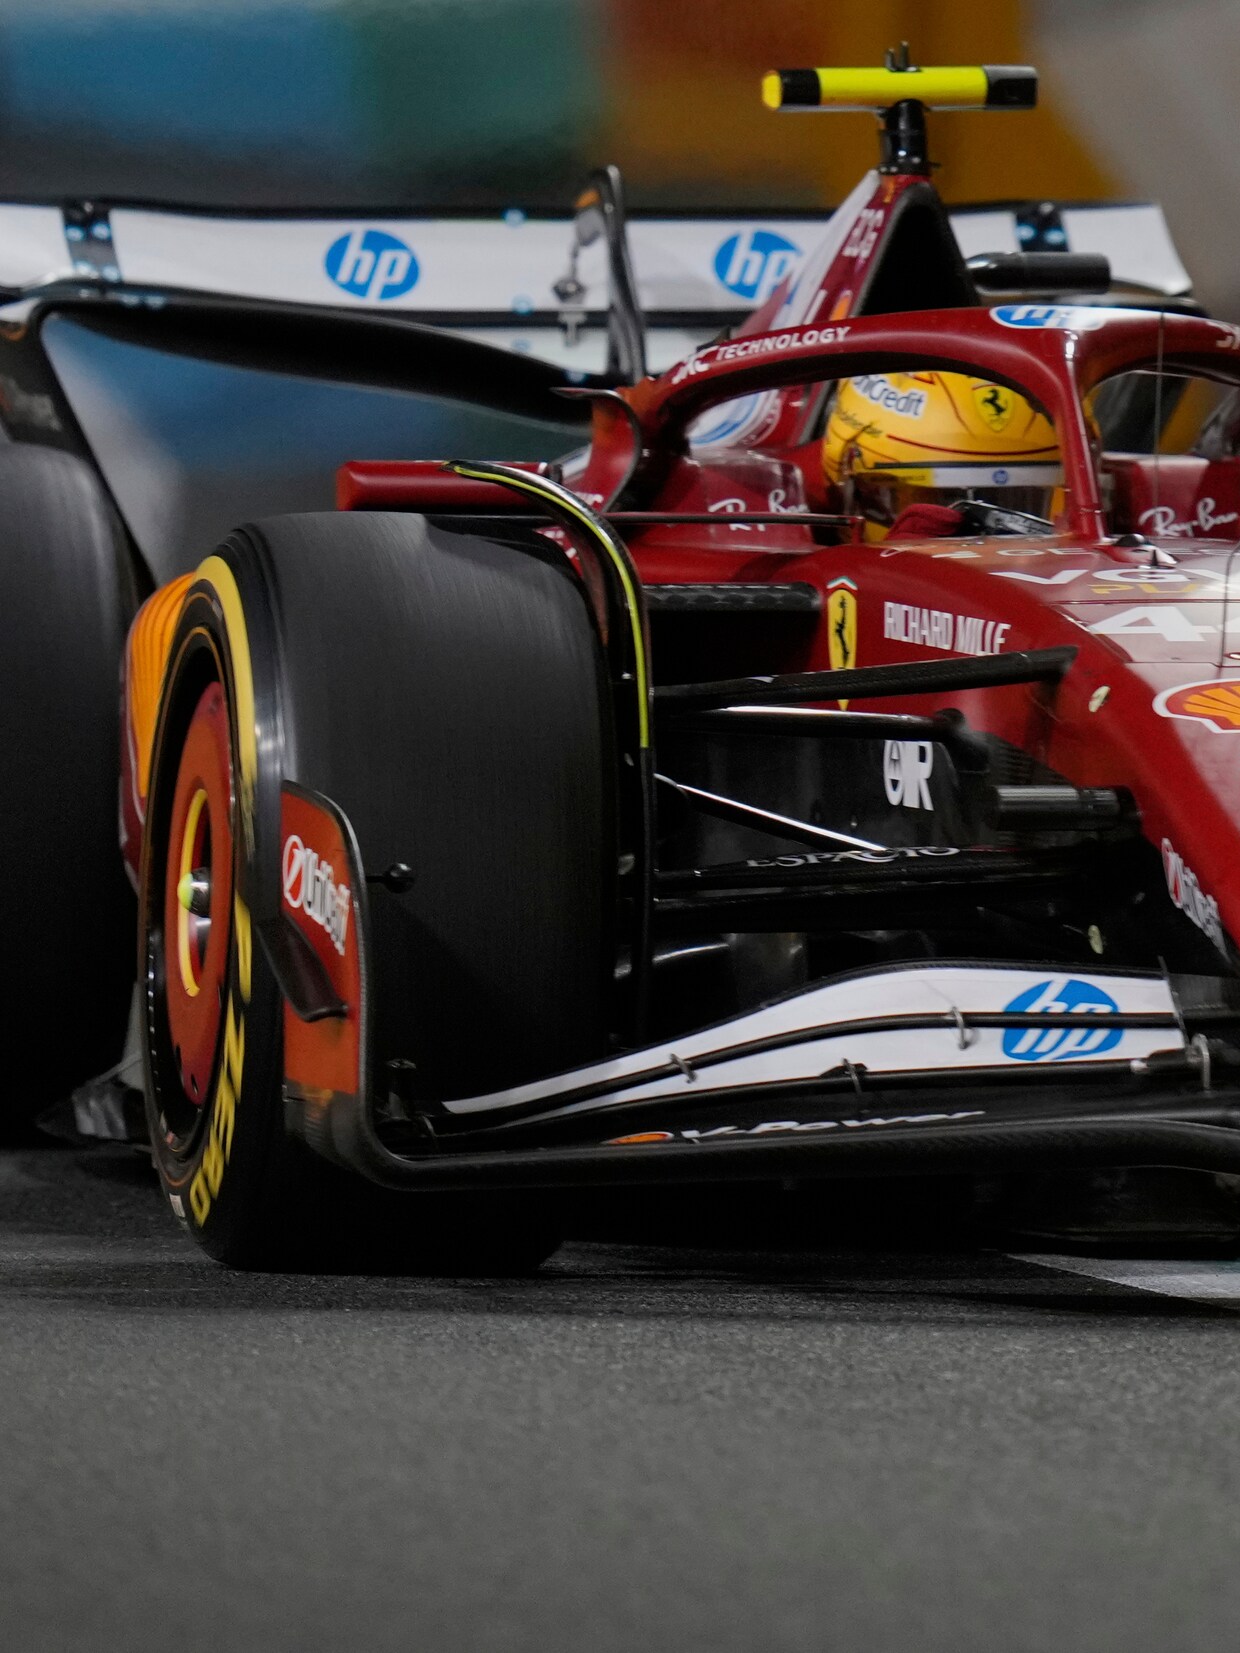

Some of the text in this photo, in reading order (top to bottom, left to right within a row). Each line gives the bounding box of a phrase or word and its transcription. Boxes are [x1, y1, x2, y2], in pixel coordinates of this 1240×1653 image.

[338, 230, 408, 299] hp
[727, 230, 799, 299] hp
[716, 326, 851, 361] TECHNOLOGY
[1138, 497, 1239, 537] Ray-Ban
[884, 601, 954, 651] RICHARD
[1010, 980, 1113, 1061] hp
